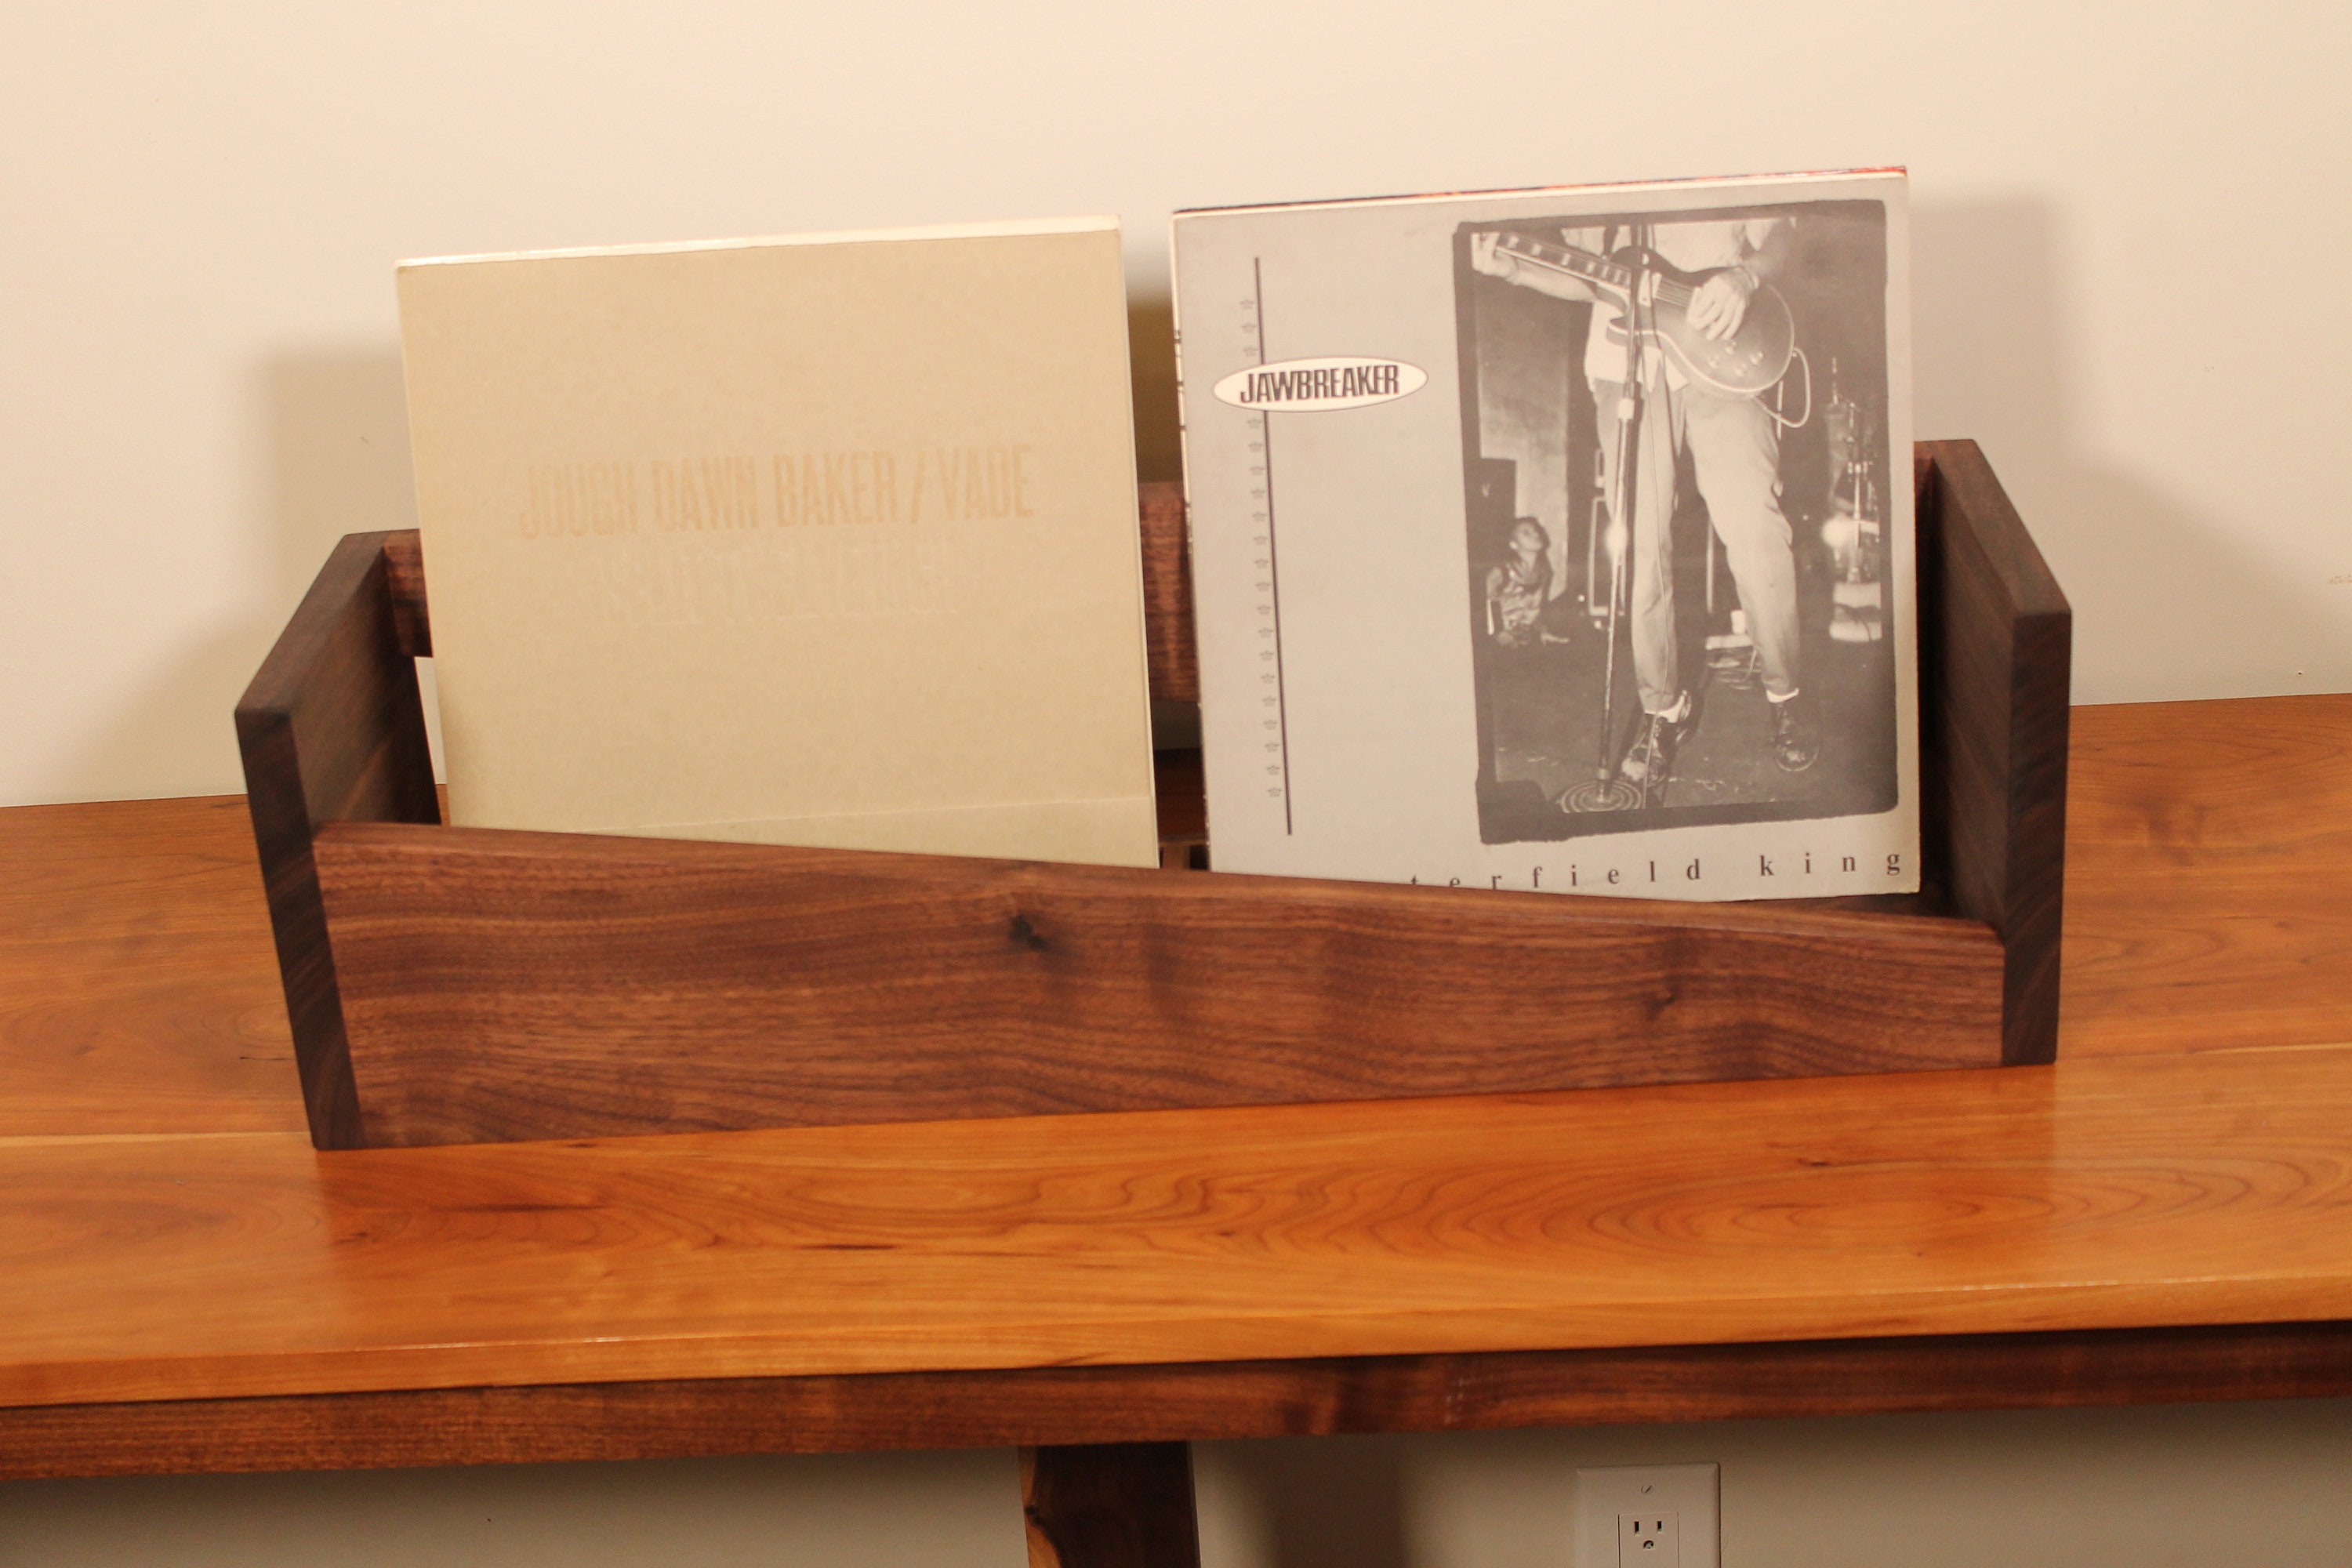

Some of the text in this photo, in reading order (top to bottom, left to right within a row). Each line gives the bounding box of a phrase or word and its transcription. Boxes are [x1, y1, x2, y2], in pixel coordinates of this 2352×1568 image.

[1240, 365, 1399, 403] JAWBREAKER
[652, 456, 759, 532] DAWN
[1759, 852, 1901, 876] king
